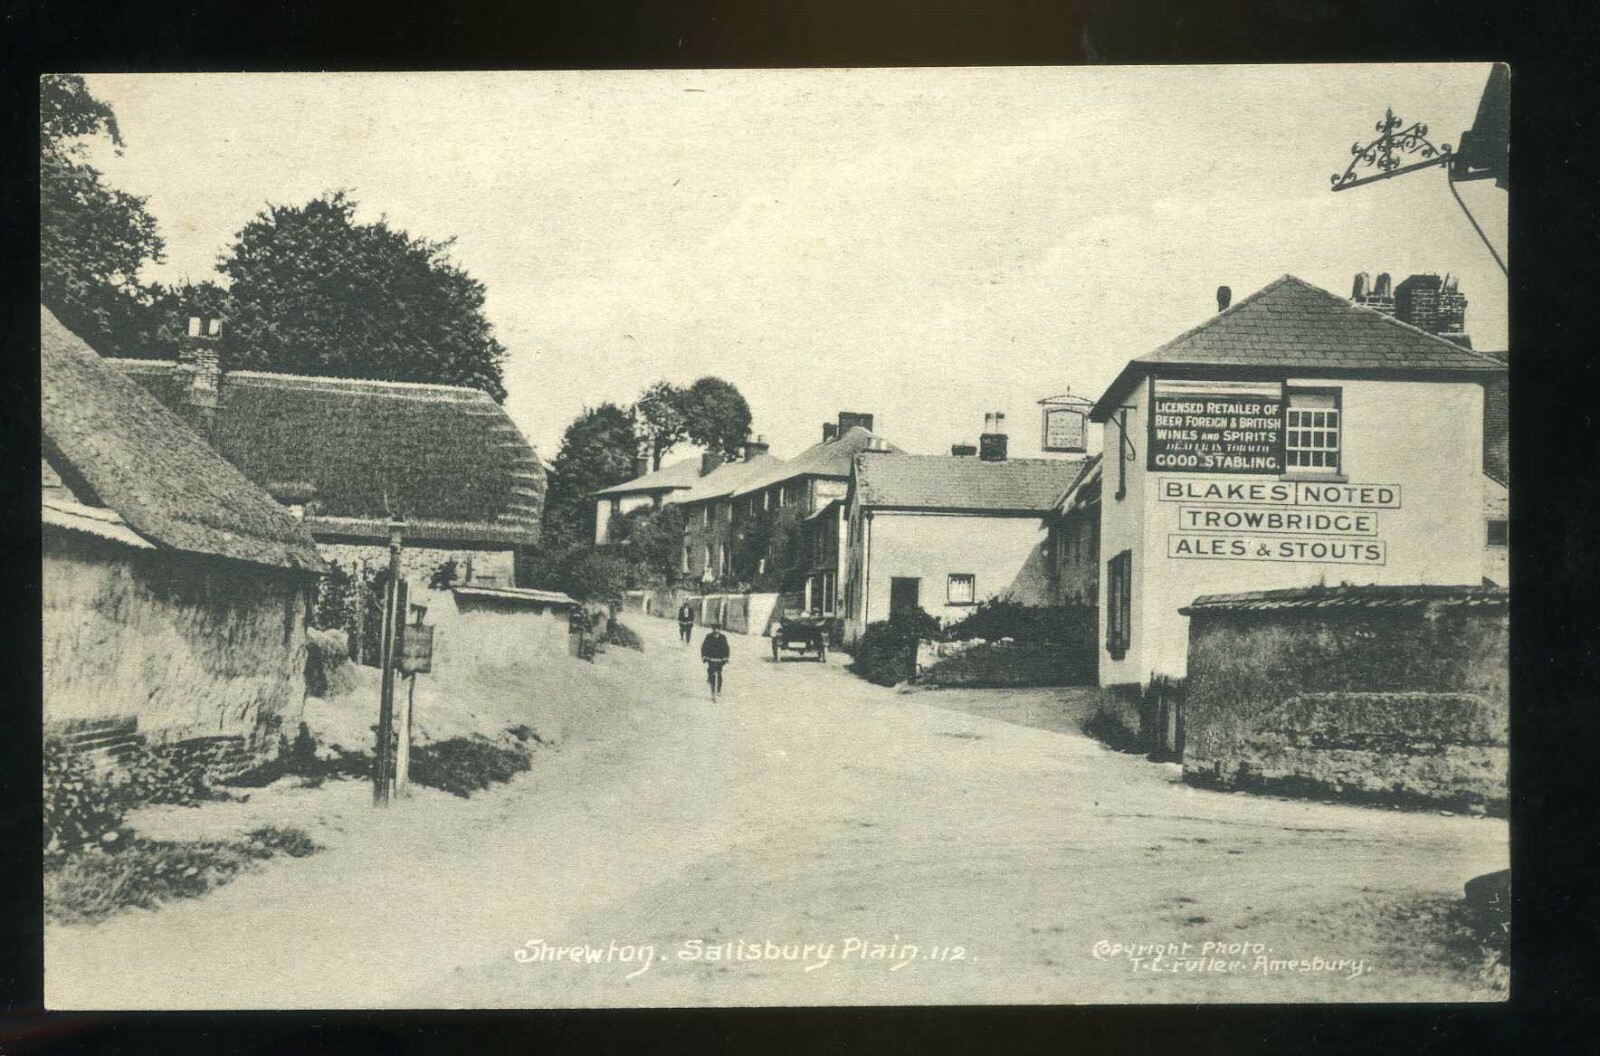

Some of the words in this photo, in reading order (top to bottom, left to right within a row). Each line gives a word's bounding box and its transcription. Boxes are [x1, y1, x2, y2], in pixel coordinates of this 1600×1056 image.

[1155, 401, 1204, 414] LICENSED
[1207, 402, 1260, 415] RETAILER
[1263, 404, 1280, 415] OF
[1155, 415, 1183, 427] BEER
[1185, 416, 1228, 428] FOREIGN
[1230, 417, 1237, 428] &
[1239, 417, 1281, 430] BRITISH
[1156, 429, 1198, 440] WINES
[1201, 432, 1220, 441] AND
[1155, 454, 1198, 467] GOOD
[1205, 455, 1281, 469] STABLING.
[1304, 486, 1394, 504] NOTED
[1187, 510, 1371, 532] TROWBRIDGE
[1175, 539, 1247, 556] ALES
[1256, 543, 1272, 557] &
[1278, 542, 1381, 561] STOUTS
